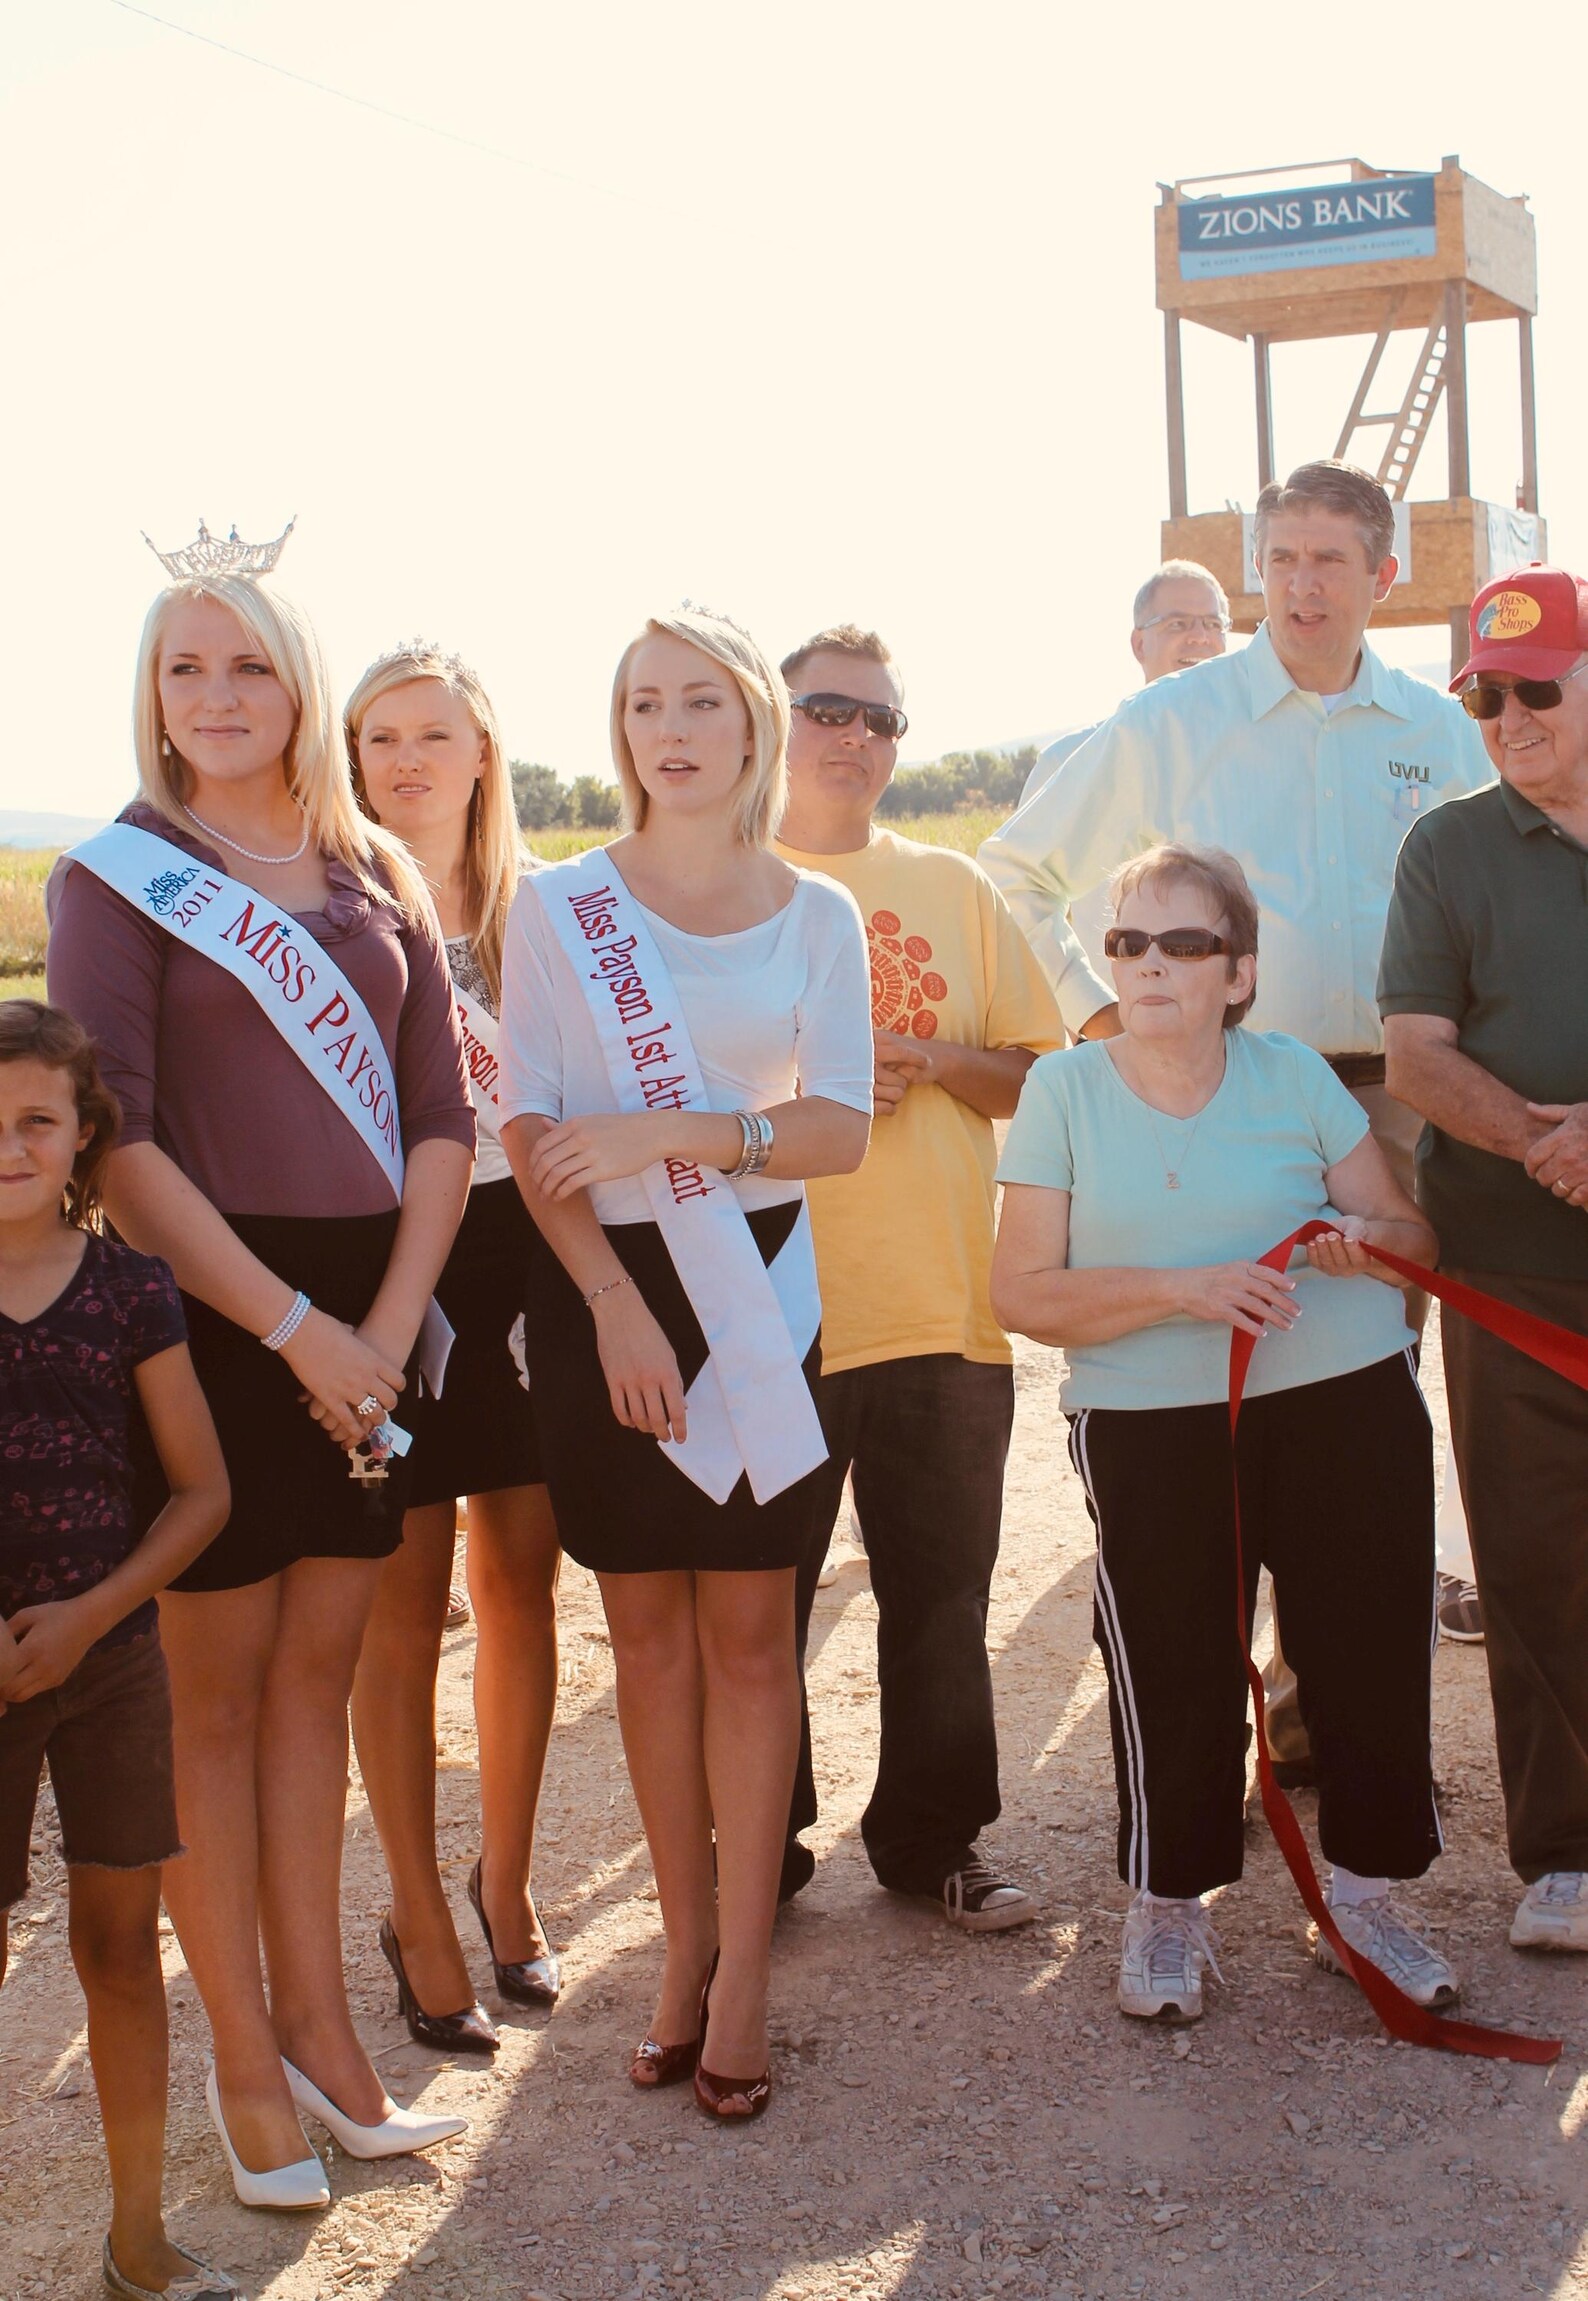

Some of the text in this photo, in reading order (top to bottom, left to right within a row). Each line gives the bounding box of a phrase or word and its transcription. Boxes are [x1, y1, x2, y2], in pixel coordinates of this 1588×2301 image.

[1199, 190, 1411, 239] ZIONS BANK
[1499, 593, 1527, 606] Bass
[1499, 605, 1519, 618] Pro
[1497, 618, 1533, 632] Shops
[1388, 760, 1431, 783] UVU
[143, 870, 178, 898] MISS
[146, 867, 200, 915] AMERICA
[172, 879, 223, 928] 2011
[567, 885, 620, 941] Miss
[590, 934, 654, 1025] Payson
[219, 900, 398, 1157] MISS PAYSON
[626, 1022, 677, 1073] 1st
